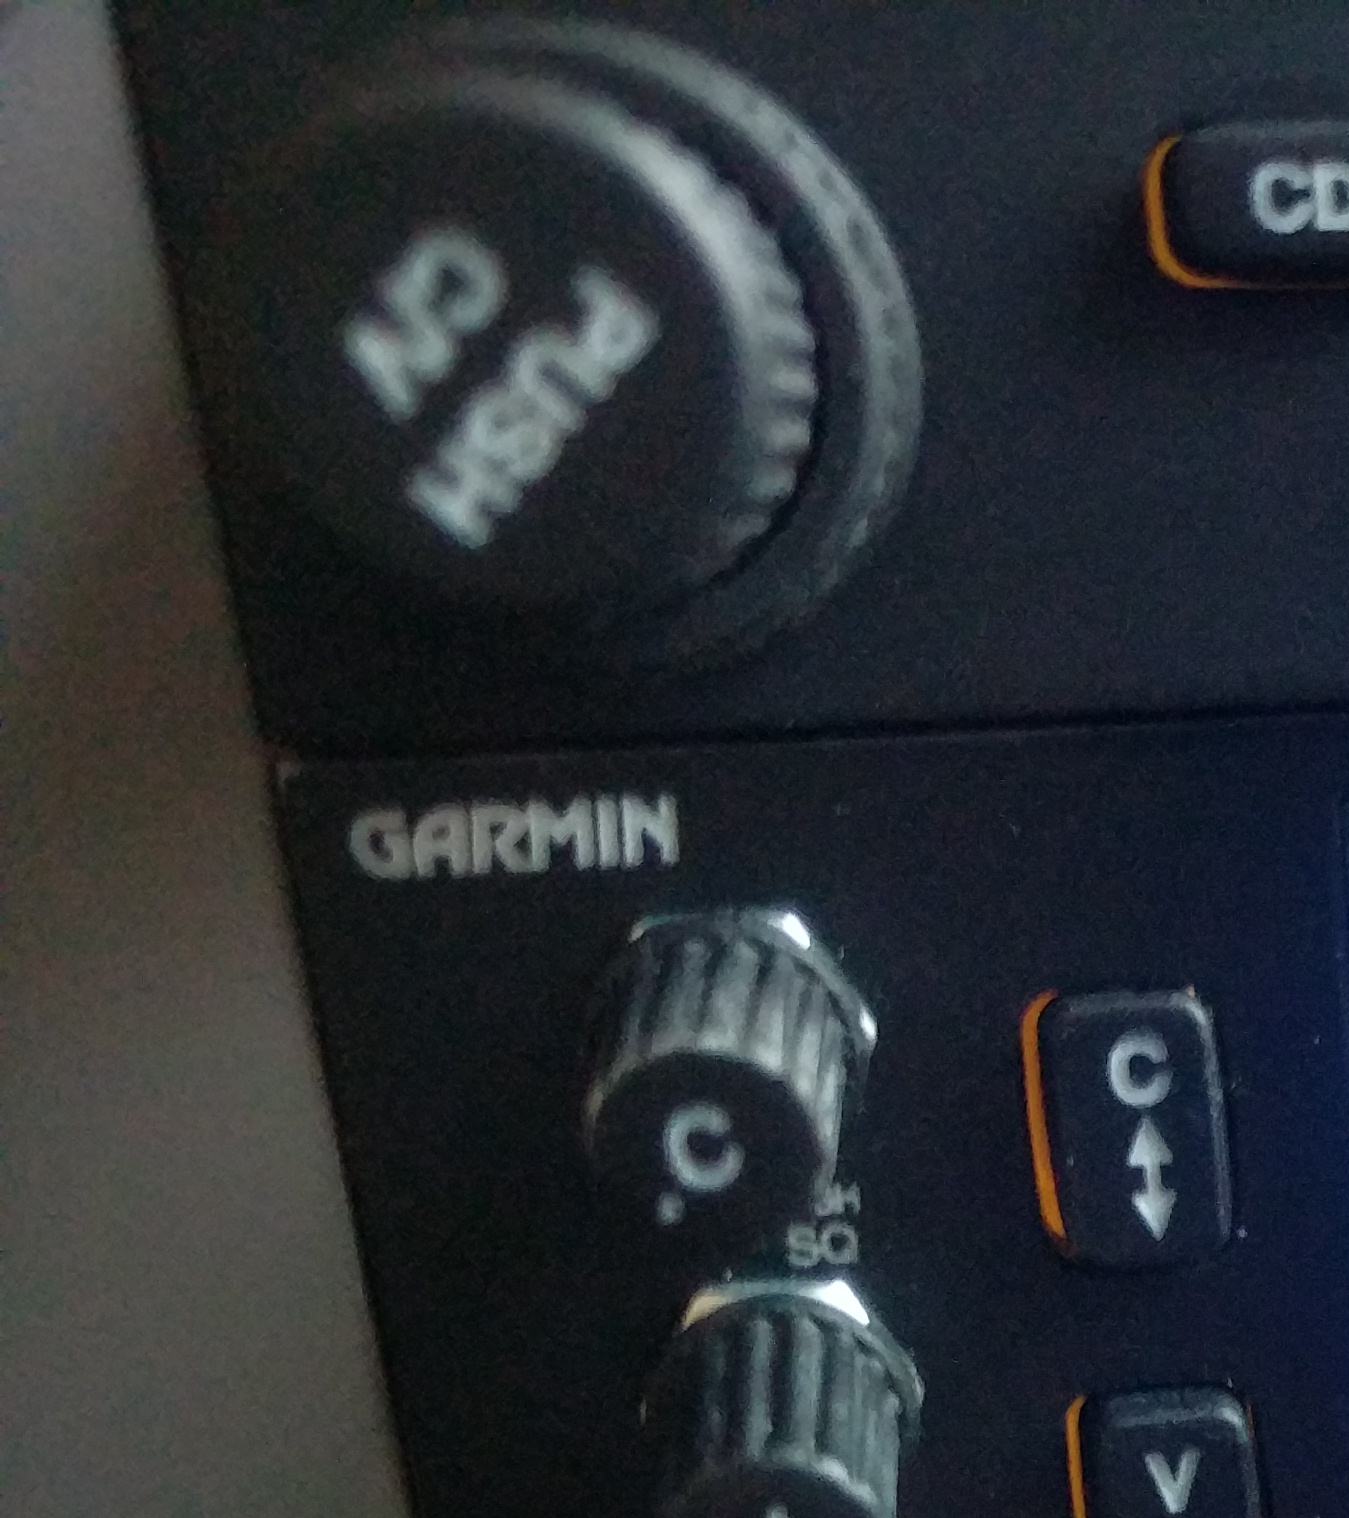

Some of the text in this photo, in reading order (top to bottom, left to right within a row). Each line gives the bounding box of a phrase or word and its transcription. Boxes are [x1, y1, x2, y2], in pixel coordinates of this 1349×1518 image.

[403, 264, 662, 550] PUSH
[348, 794, 681, 880] GARMIN
[1106, 1030, 1175, 1109] C
[661, 1099, 746, 1194] C
[1142, 1449, 1202, 1514] V
